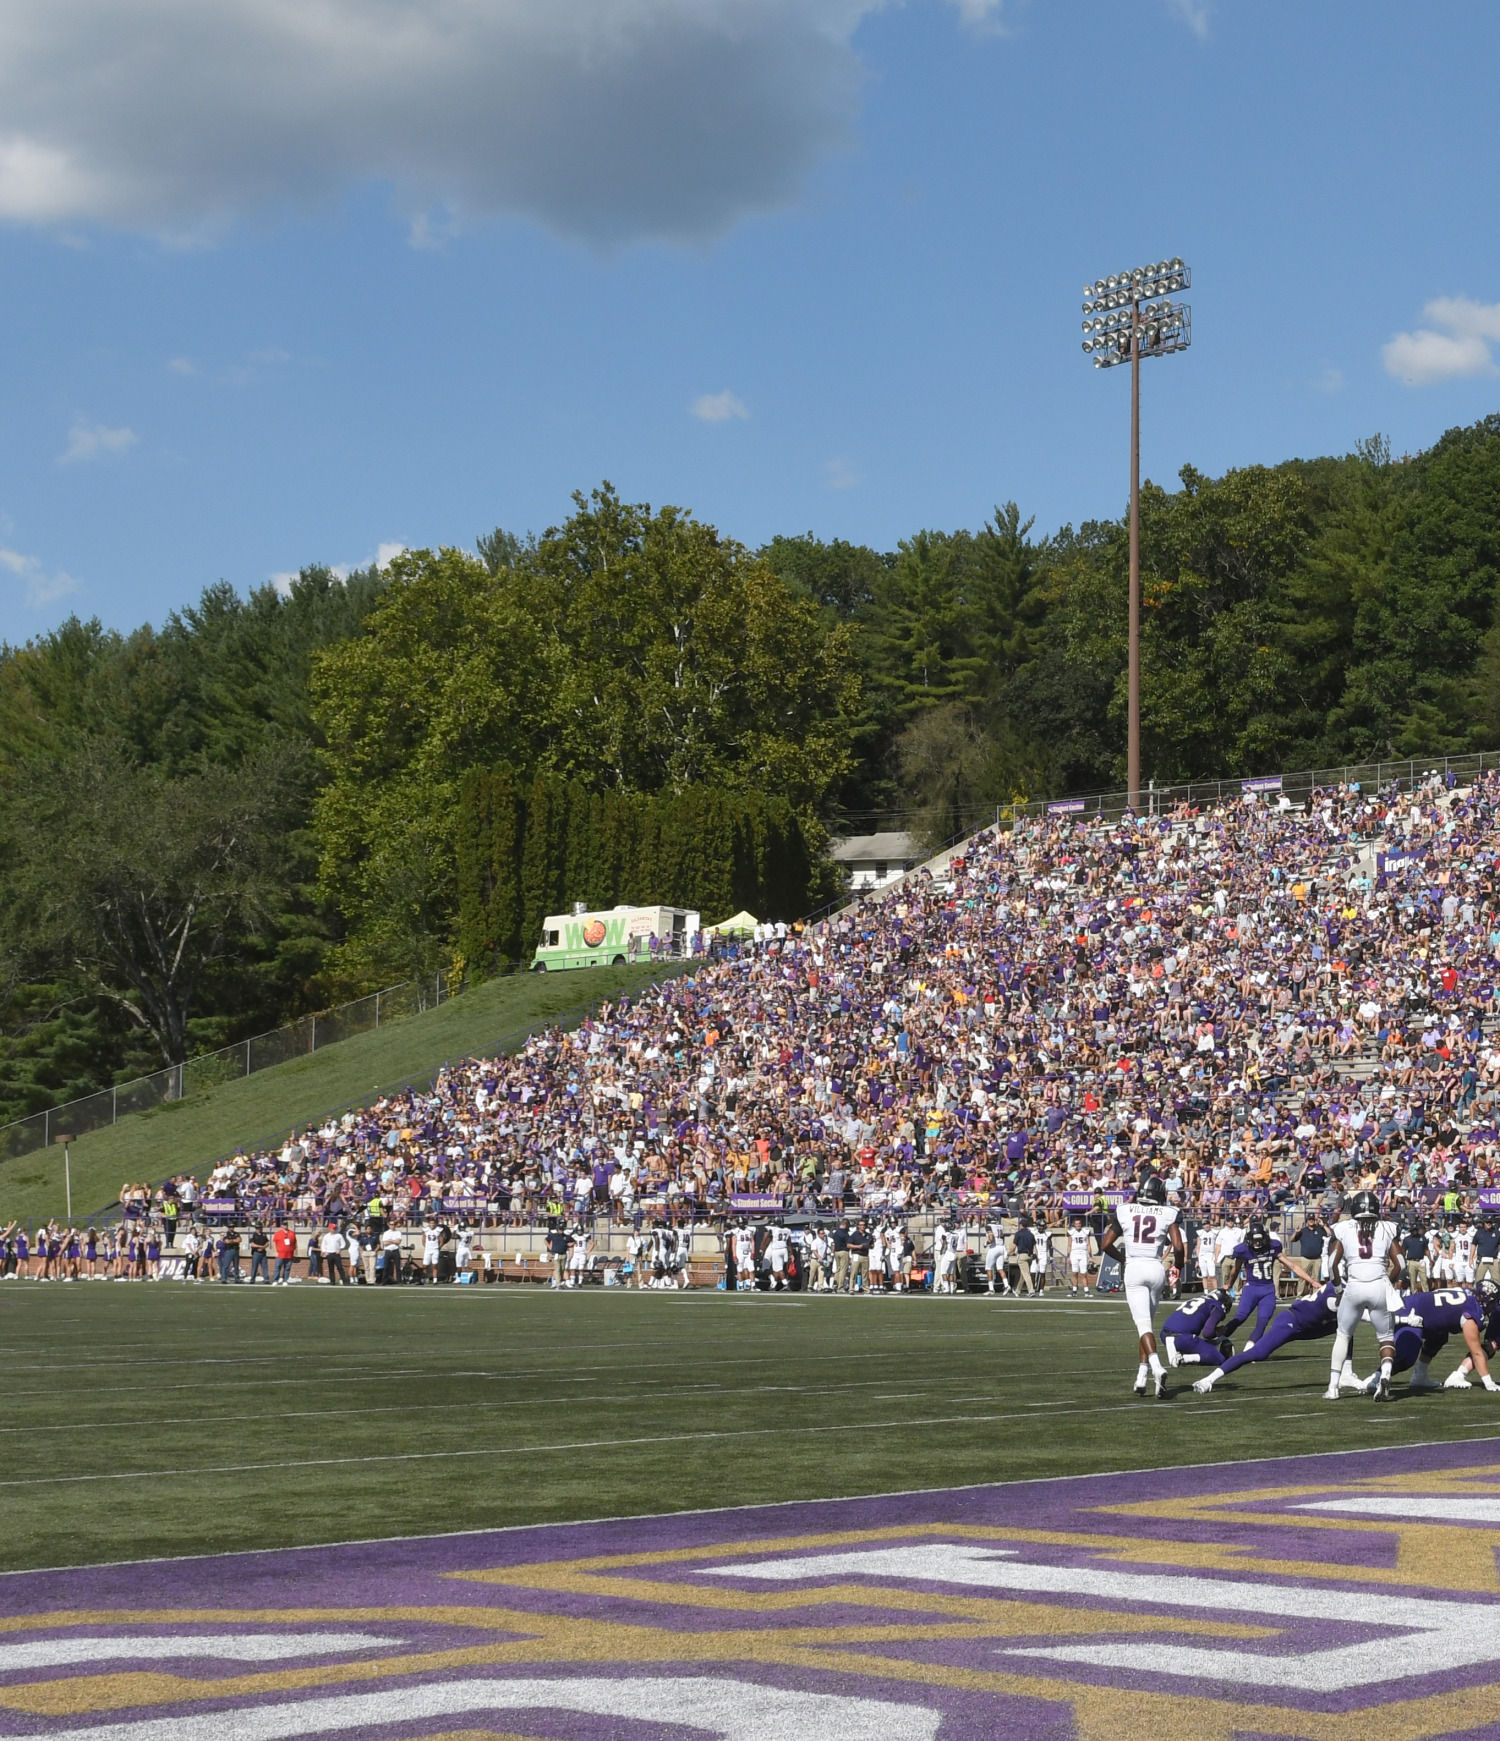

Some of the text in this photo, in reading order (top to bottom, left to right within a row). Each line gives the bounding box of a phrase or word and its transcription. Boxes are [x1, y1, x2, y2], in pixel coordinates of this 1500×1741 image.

[1071, 1194, 1088, 1206] GOLD
[1129, 1204, 1163, 1216] WILLIAMS
[1132, 1214, 1157, 1244] 12
[1203, 1236, 1212, 1246] 21
[1252, 1261, 1273, 1280] 40
